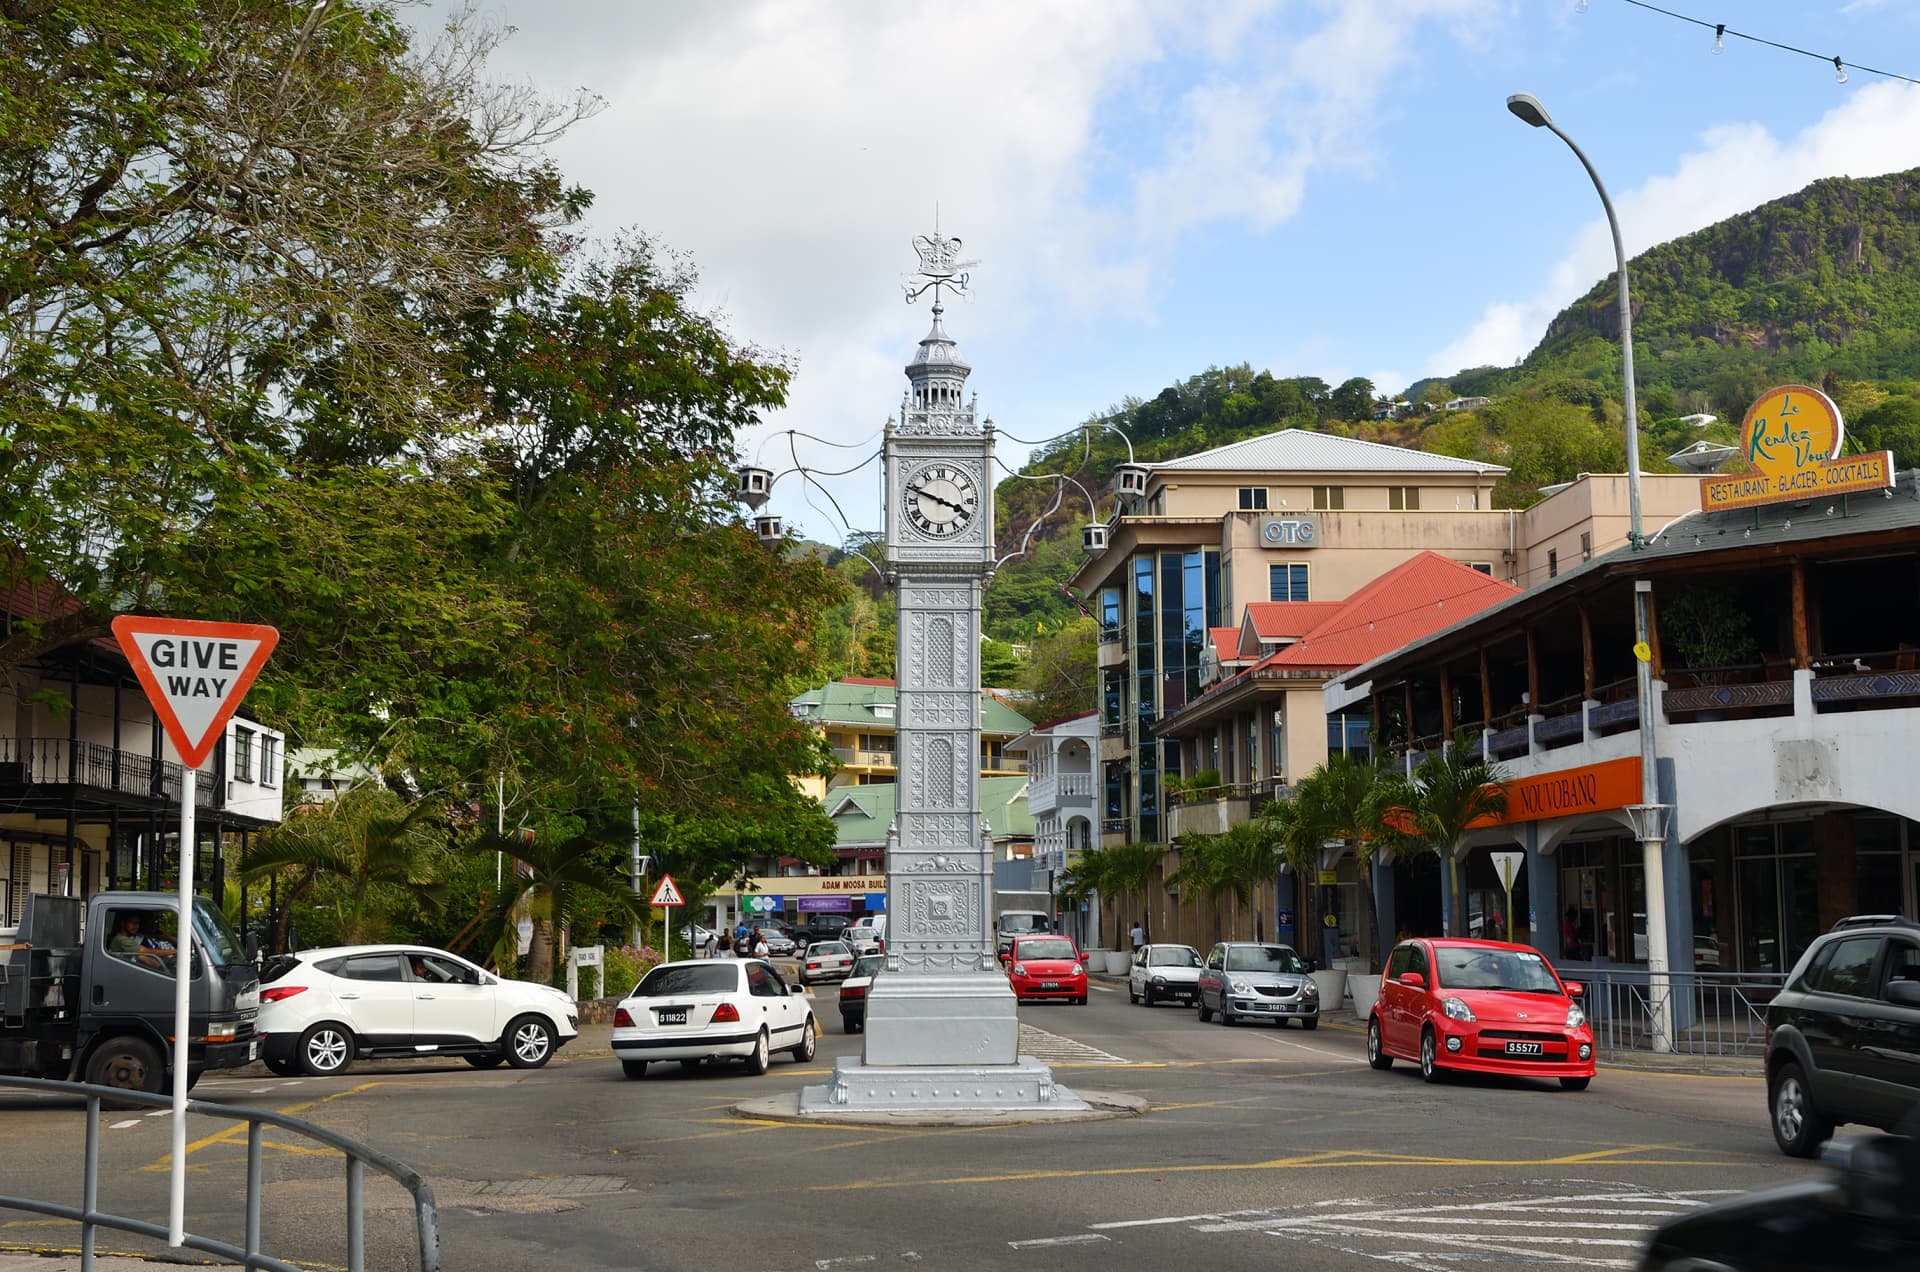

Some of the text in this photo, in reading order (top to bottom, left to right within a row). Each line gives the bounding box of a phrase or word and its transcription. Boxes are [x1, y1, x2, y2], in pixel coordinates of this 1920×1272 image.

[1749, 418, 1812, 463] Rendez
[1795, 440, 1830, 468] Vous
[1710, 478, 1770, 502] RESTAURANT
[1778, 470, 1818, 492] GLACIER
[1826, 462, 1880, 485] COCKTAILS
[1265, 520, 1313, 543] OTC
[151, 639, 238, 670] GIVE
[168, 676, 227, 698] WAY
[1520, 774, 1597, 815] NOUVOBANQ
[822, 880, 840, 889] ADAM
[843, 880, 865, 889] MOOSA
